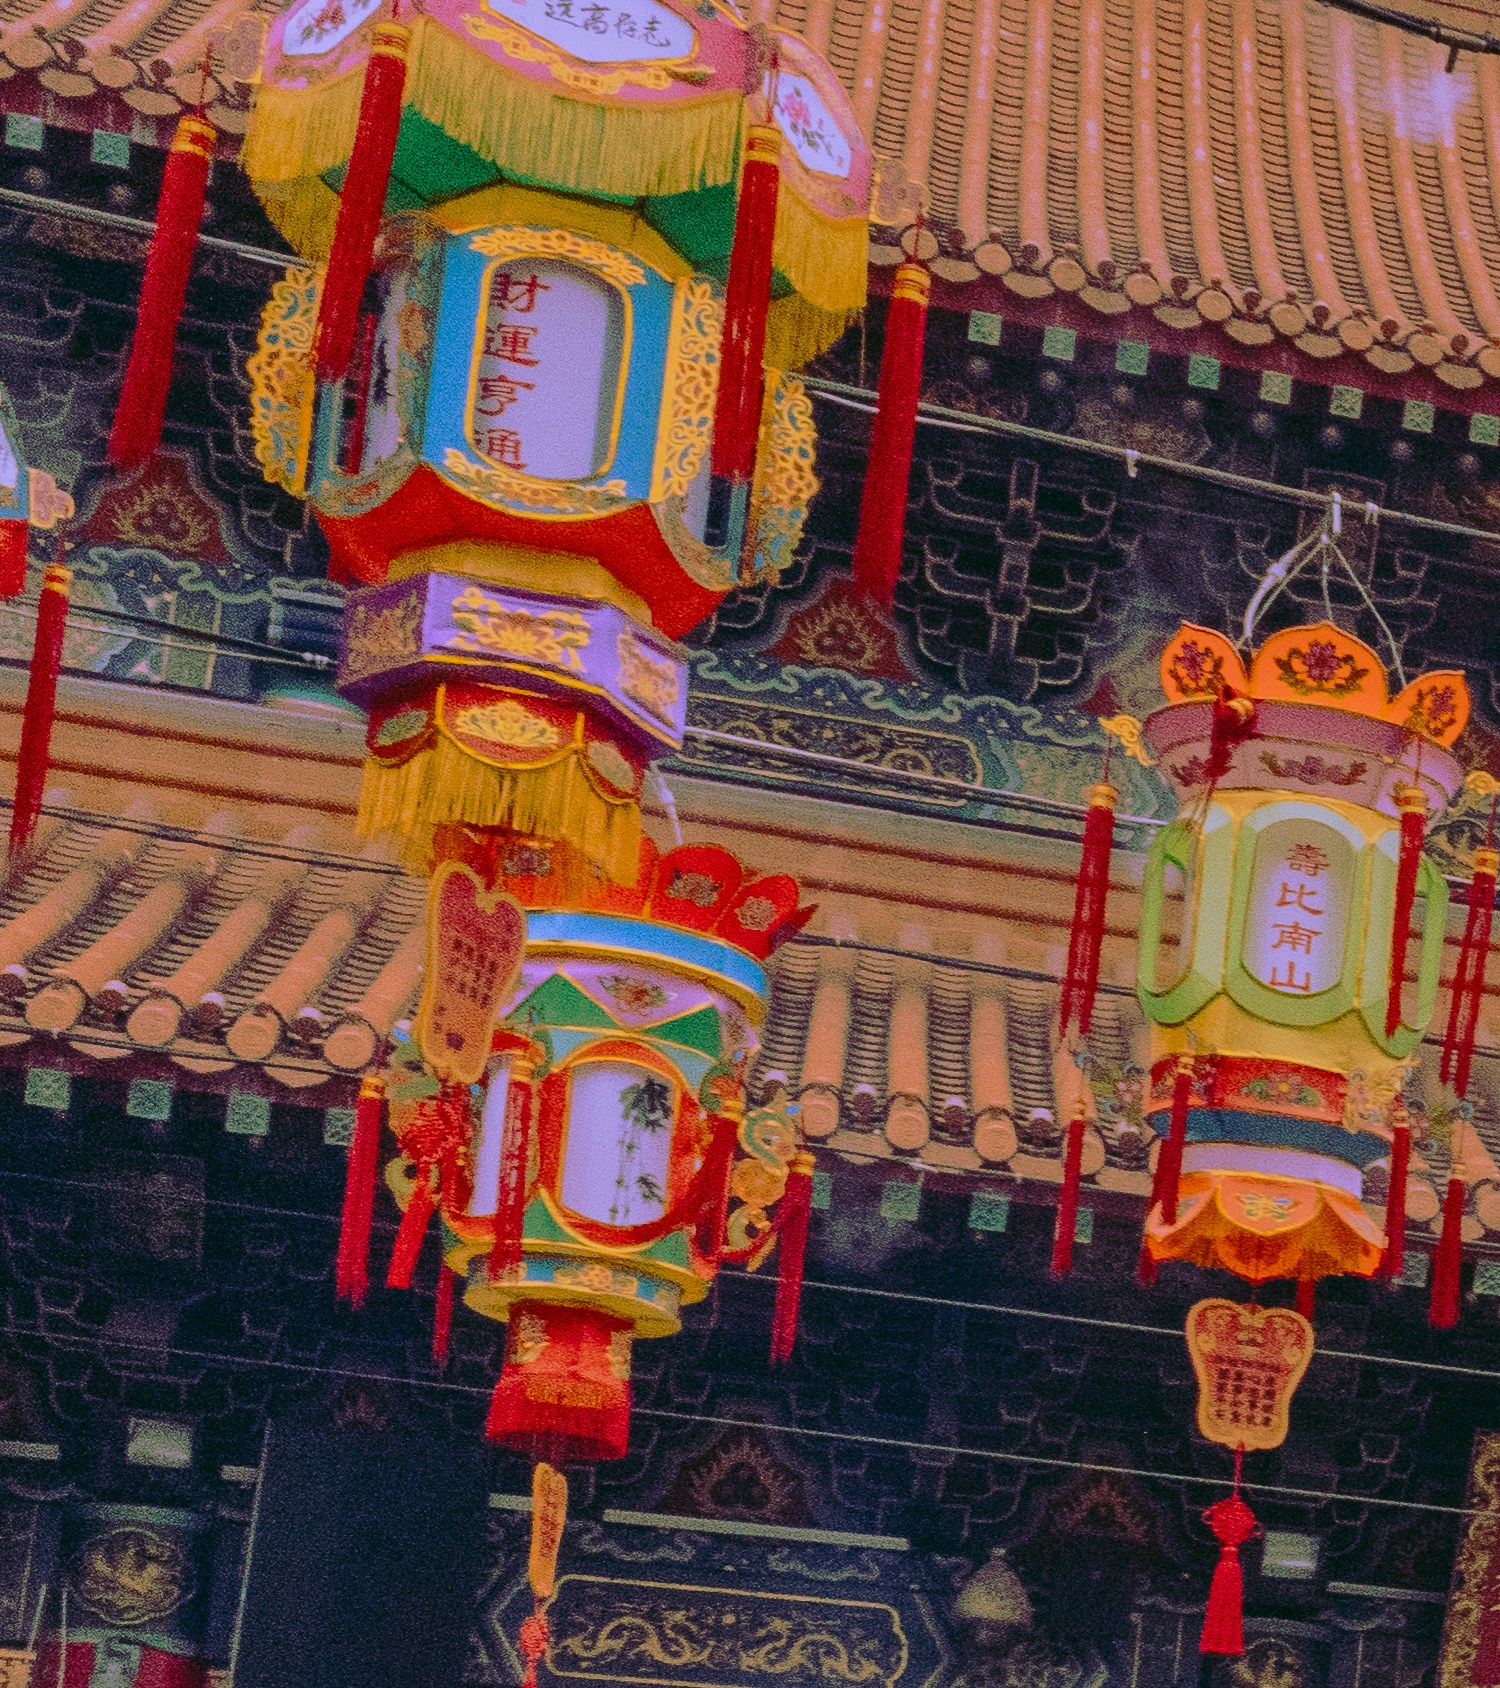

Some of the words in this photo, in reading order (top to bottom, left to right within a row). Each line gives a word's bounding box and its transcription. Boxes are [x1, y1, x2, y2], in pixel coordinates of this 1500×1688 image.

[472, 272, 550, 470] 財運亨通
[1268, 843, 1330, 992] 壽比南山
